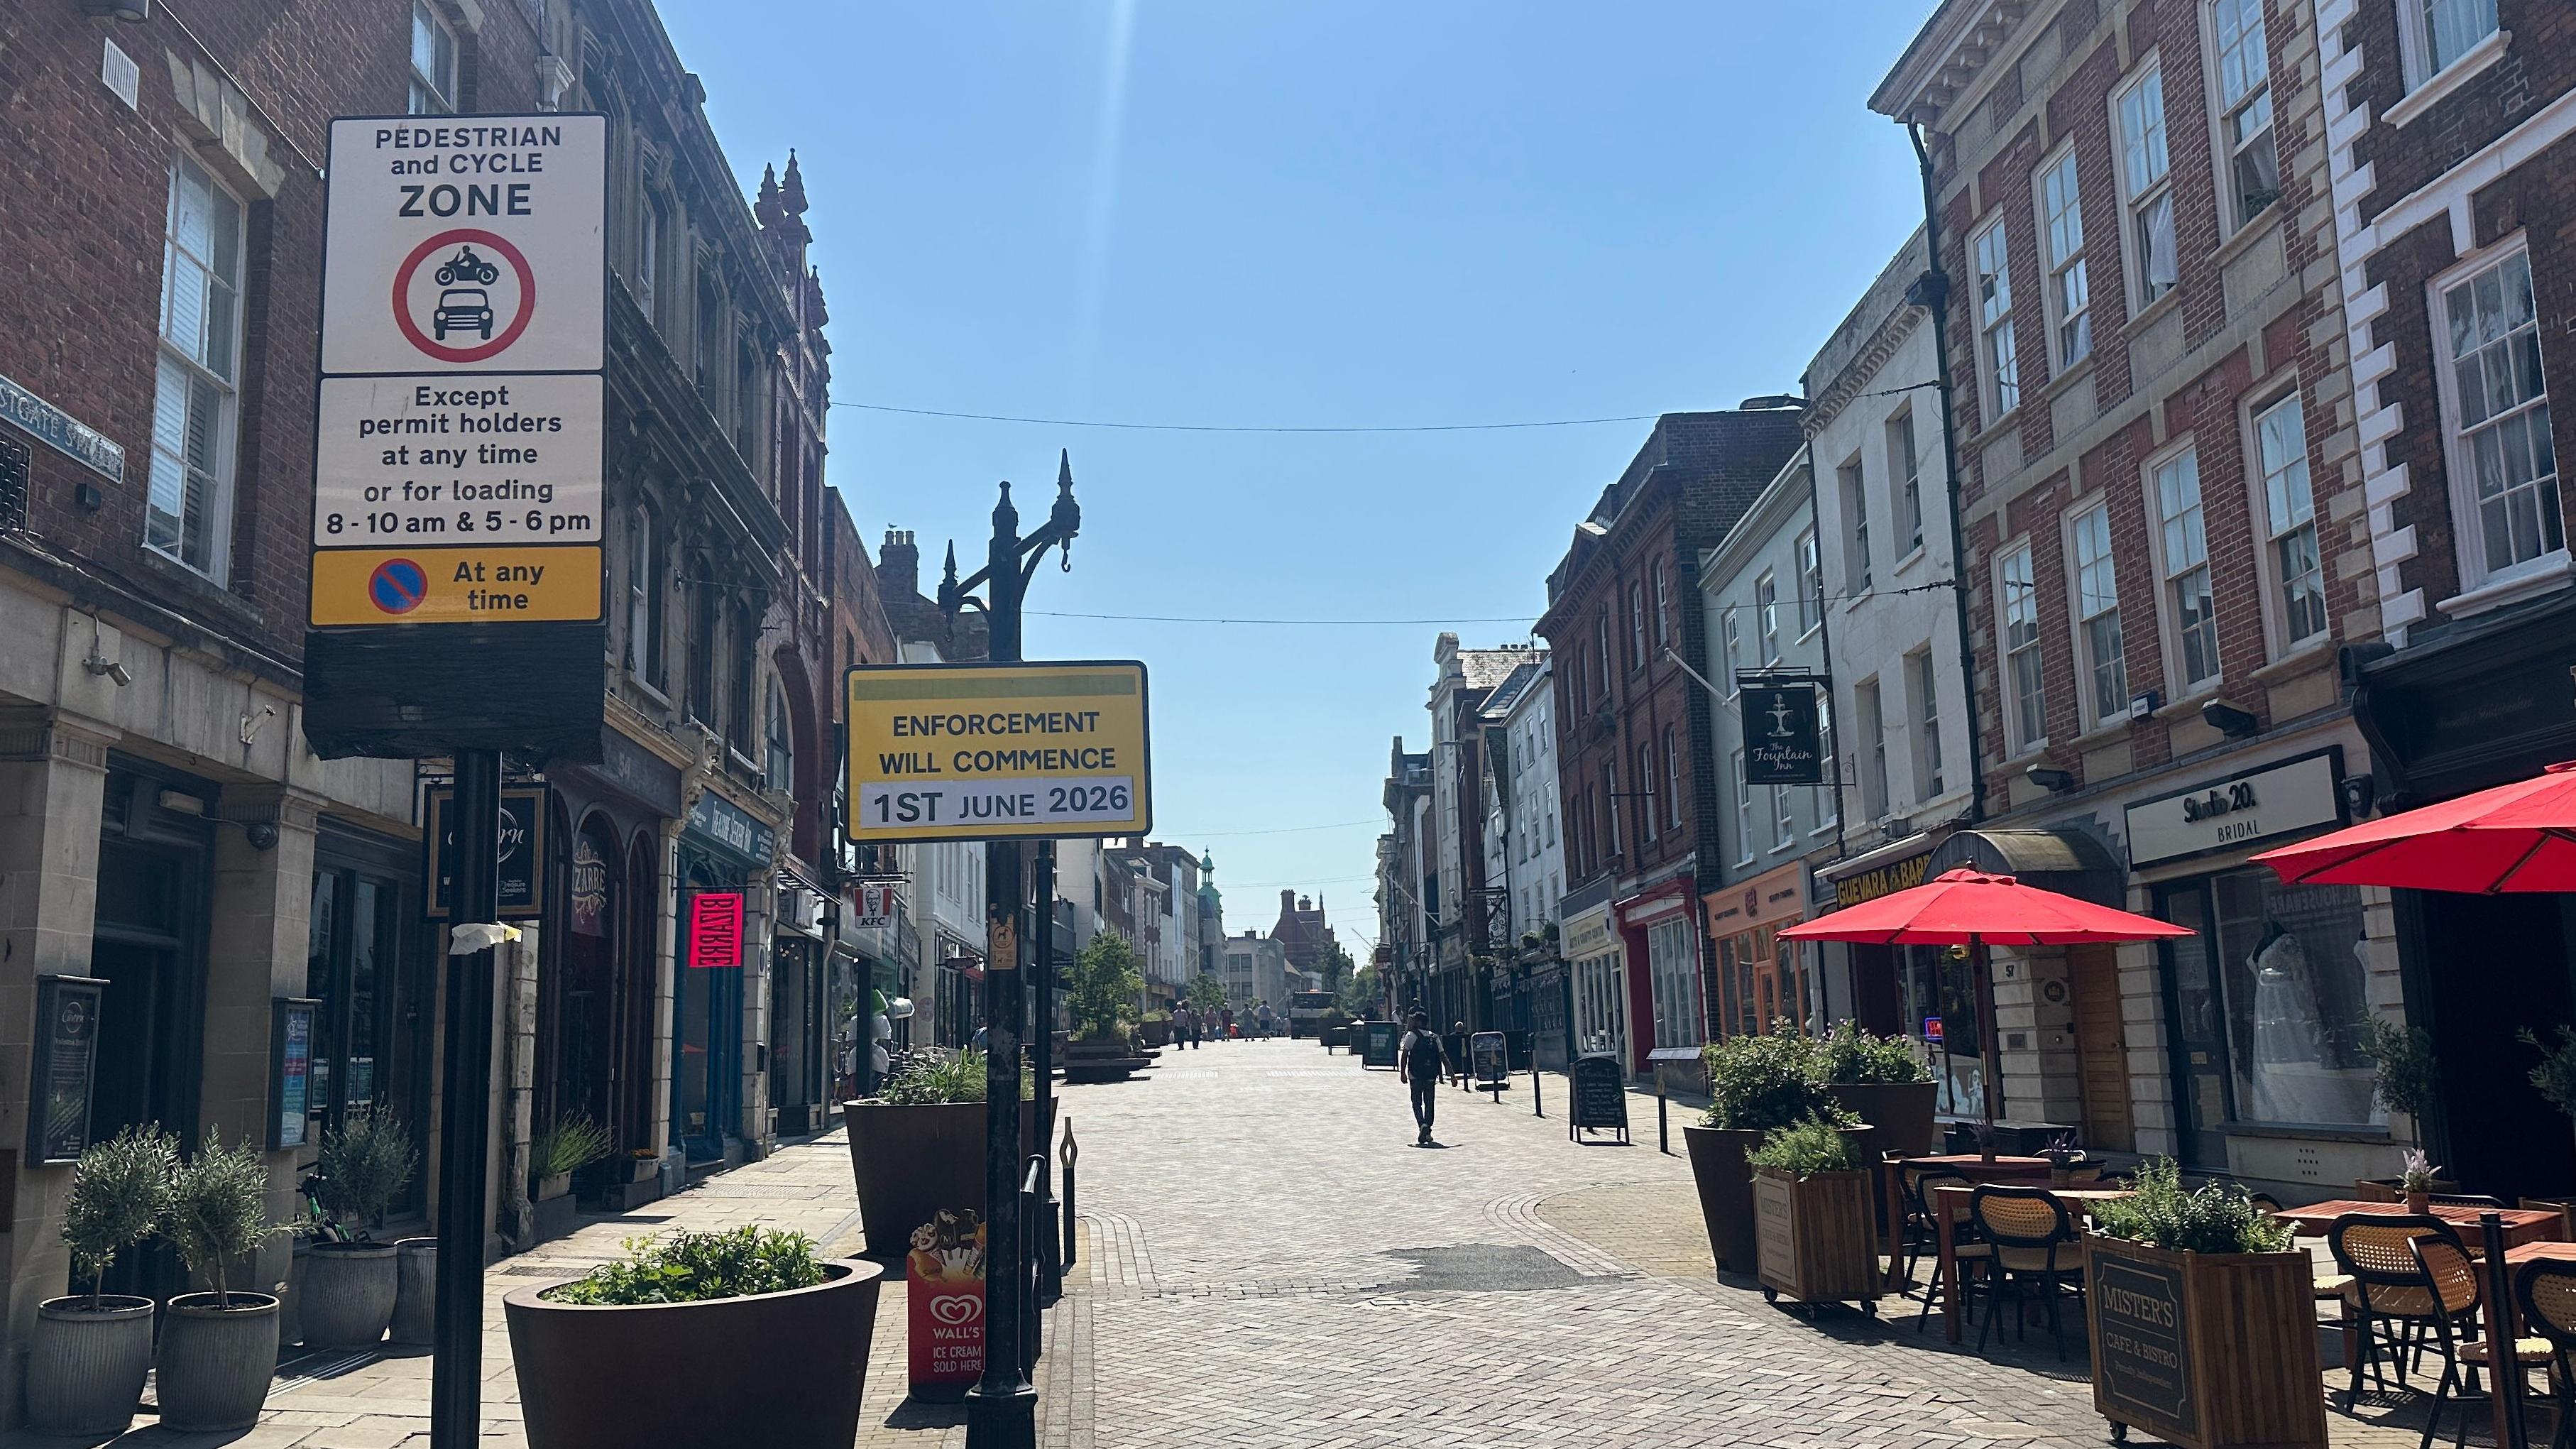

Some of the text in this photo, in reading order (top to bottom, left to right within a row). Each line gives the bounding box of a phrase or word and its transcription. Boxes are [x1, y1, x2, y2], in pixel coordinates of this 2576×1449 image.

[376, 126, 561, 148] PEDESTRIAN
[391, 153, 543, 175] and CYCLE
[399, 183, 531, 217] ZONE
[416, 386, 509, 409] Except
[359, 412, 561, 438] permit holders
[382, 444, 538, 468] at any time
[364, 479, 553, 503] or for loading
[457, 512, 474, 531] &
[454, 561, 544, 585] At any
[468, 589, 529, 611] time
[893, 711, 1100, 737] ENFORCEMENT
[1753, 745, 1812, 762] Fountain
[1770, 741, 1784, 750] The
[879, 748, 1116, 774] WILL COMMENCE
[1774, 760, 1794, 771] Inn
[874, 785, 1128, 823] 1ST JUNE 2026
[2183, 790, 2228, 823] Studio
[2218, 819, 2260, 843] BRIDAL
[1837, 870, 1888, 905] GUEVARA
[860, 917, 886, 926] KFC
[2005, 965, 2015, 978] 57
[2103, 1285, 2174, 1328] MISTER'S
[933, 1327, 980, 1340] WALL'S
[933, 1345, 982, 1359] ICE CREAM
[2106, 1332, 2177, 1369] CAFE & BISTRO
[933, 1360, 982, 1373] SOLD HERE
